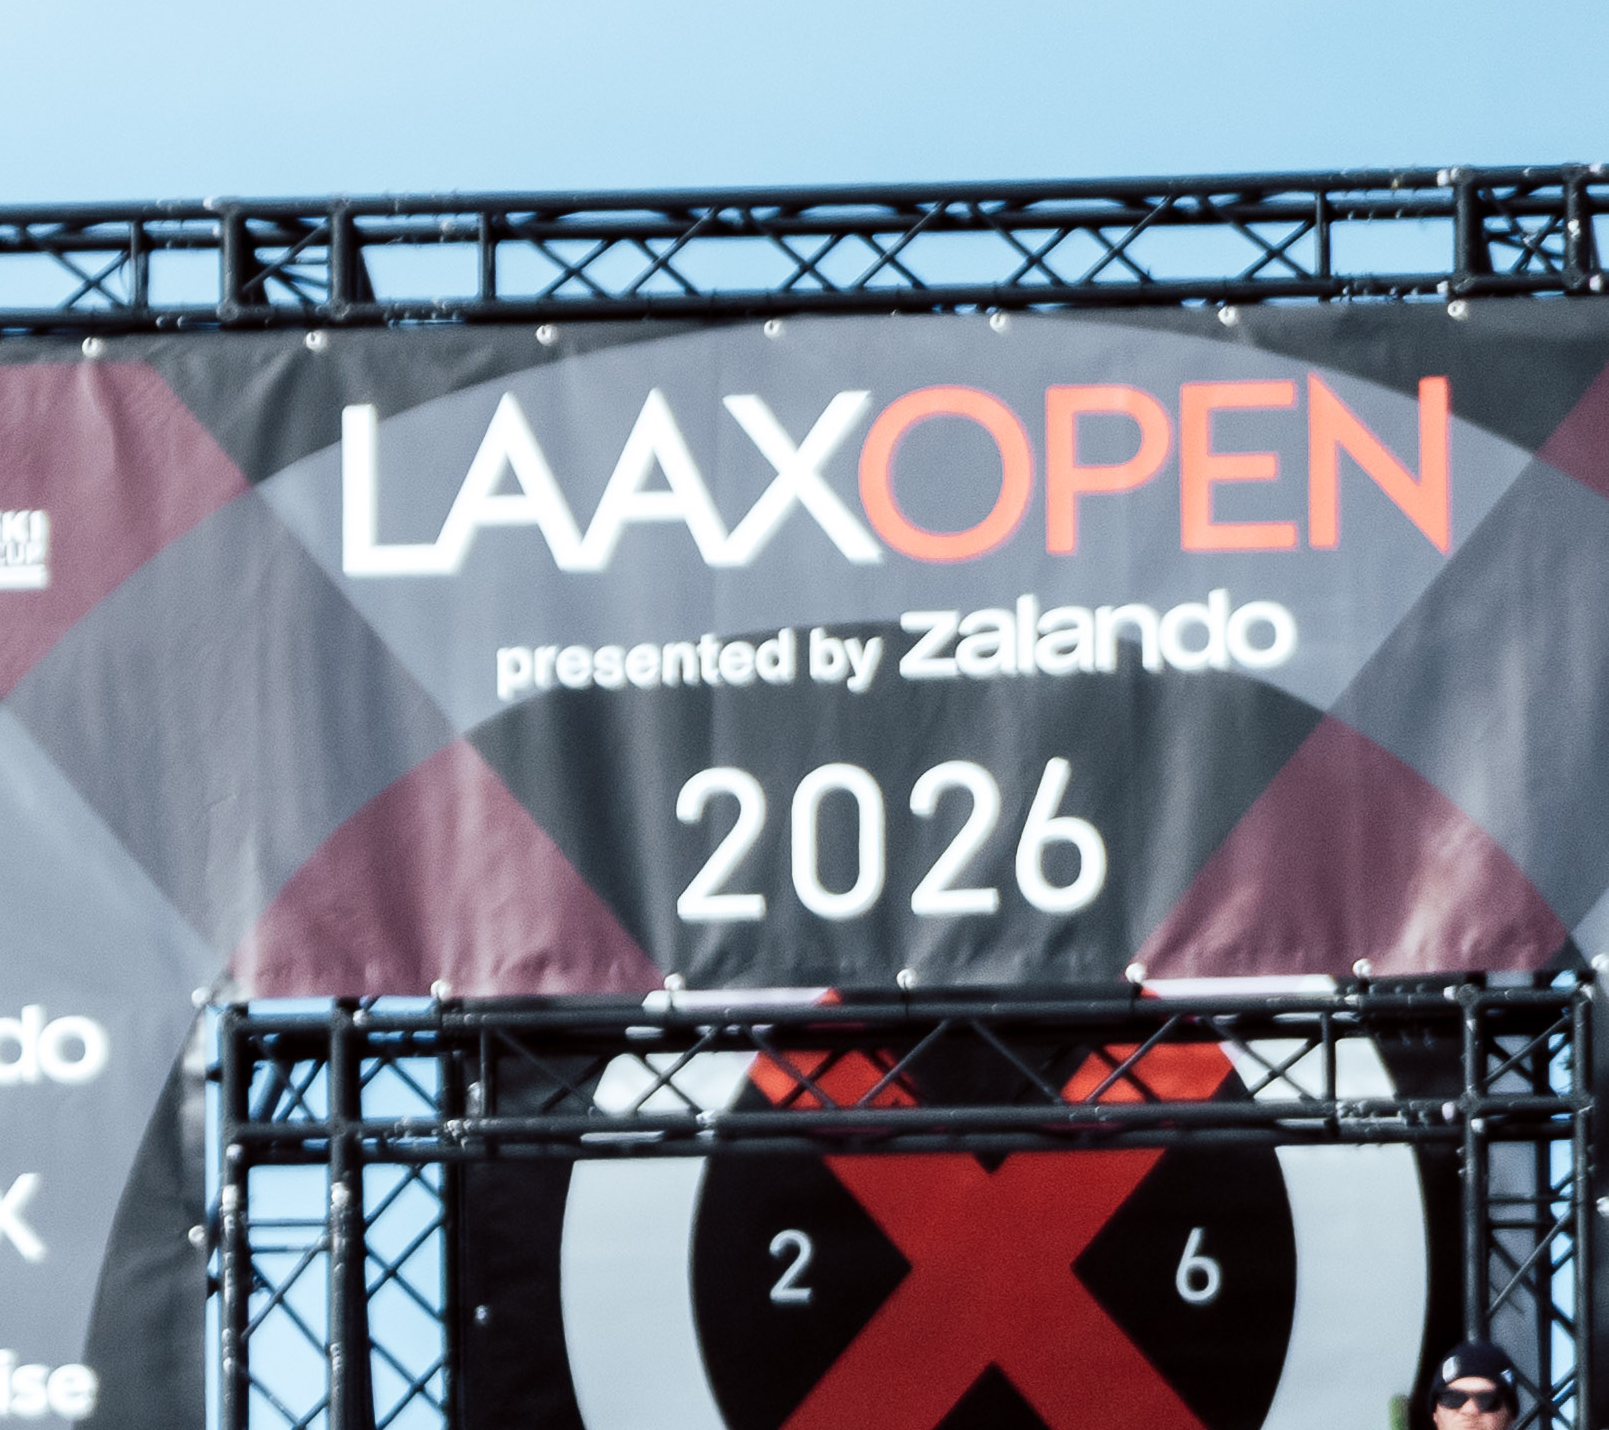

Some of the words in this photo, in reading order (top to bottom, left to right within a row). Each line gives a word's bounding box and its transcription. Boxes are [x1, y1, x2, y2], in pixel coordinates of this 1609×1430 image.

[496, 627, 794, 699] presented
[809, 627, 880, 690] by
[899, 589, 1296, 677] zalando
[676, 757, 1106, 921] 2026
[769, 1229, 814, 1304] 2
[1175, 1228, 1222, 1305] 6
